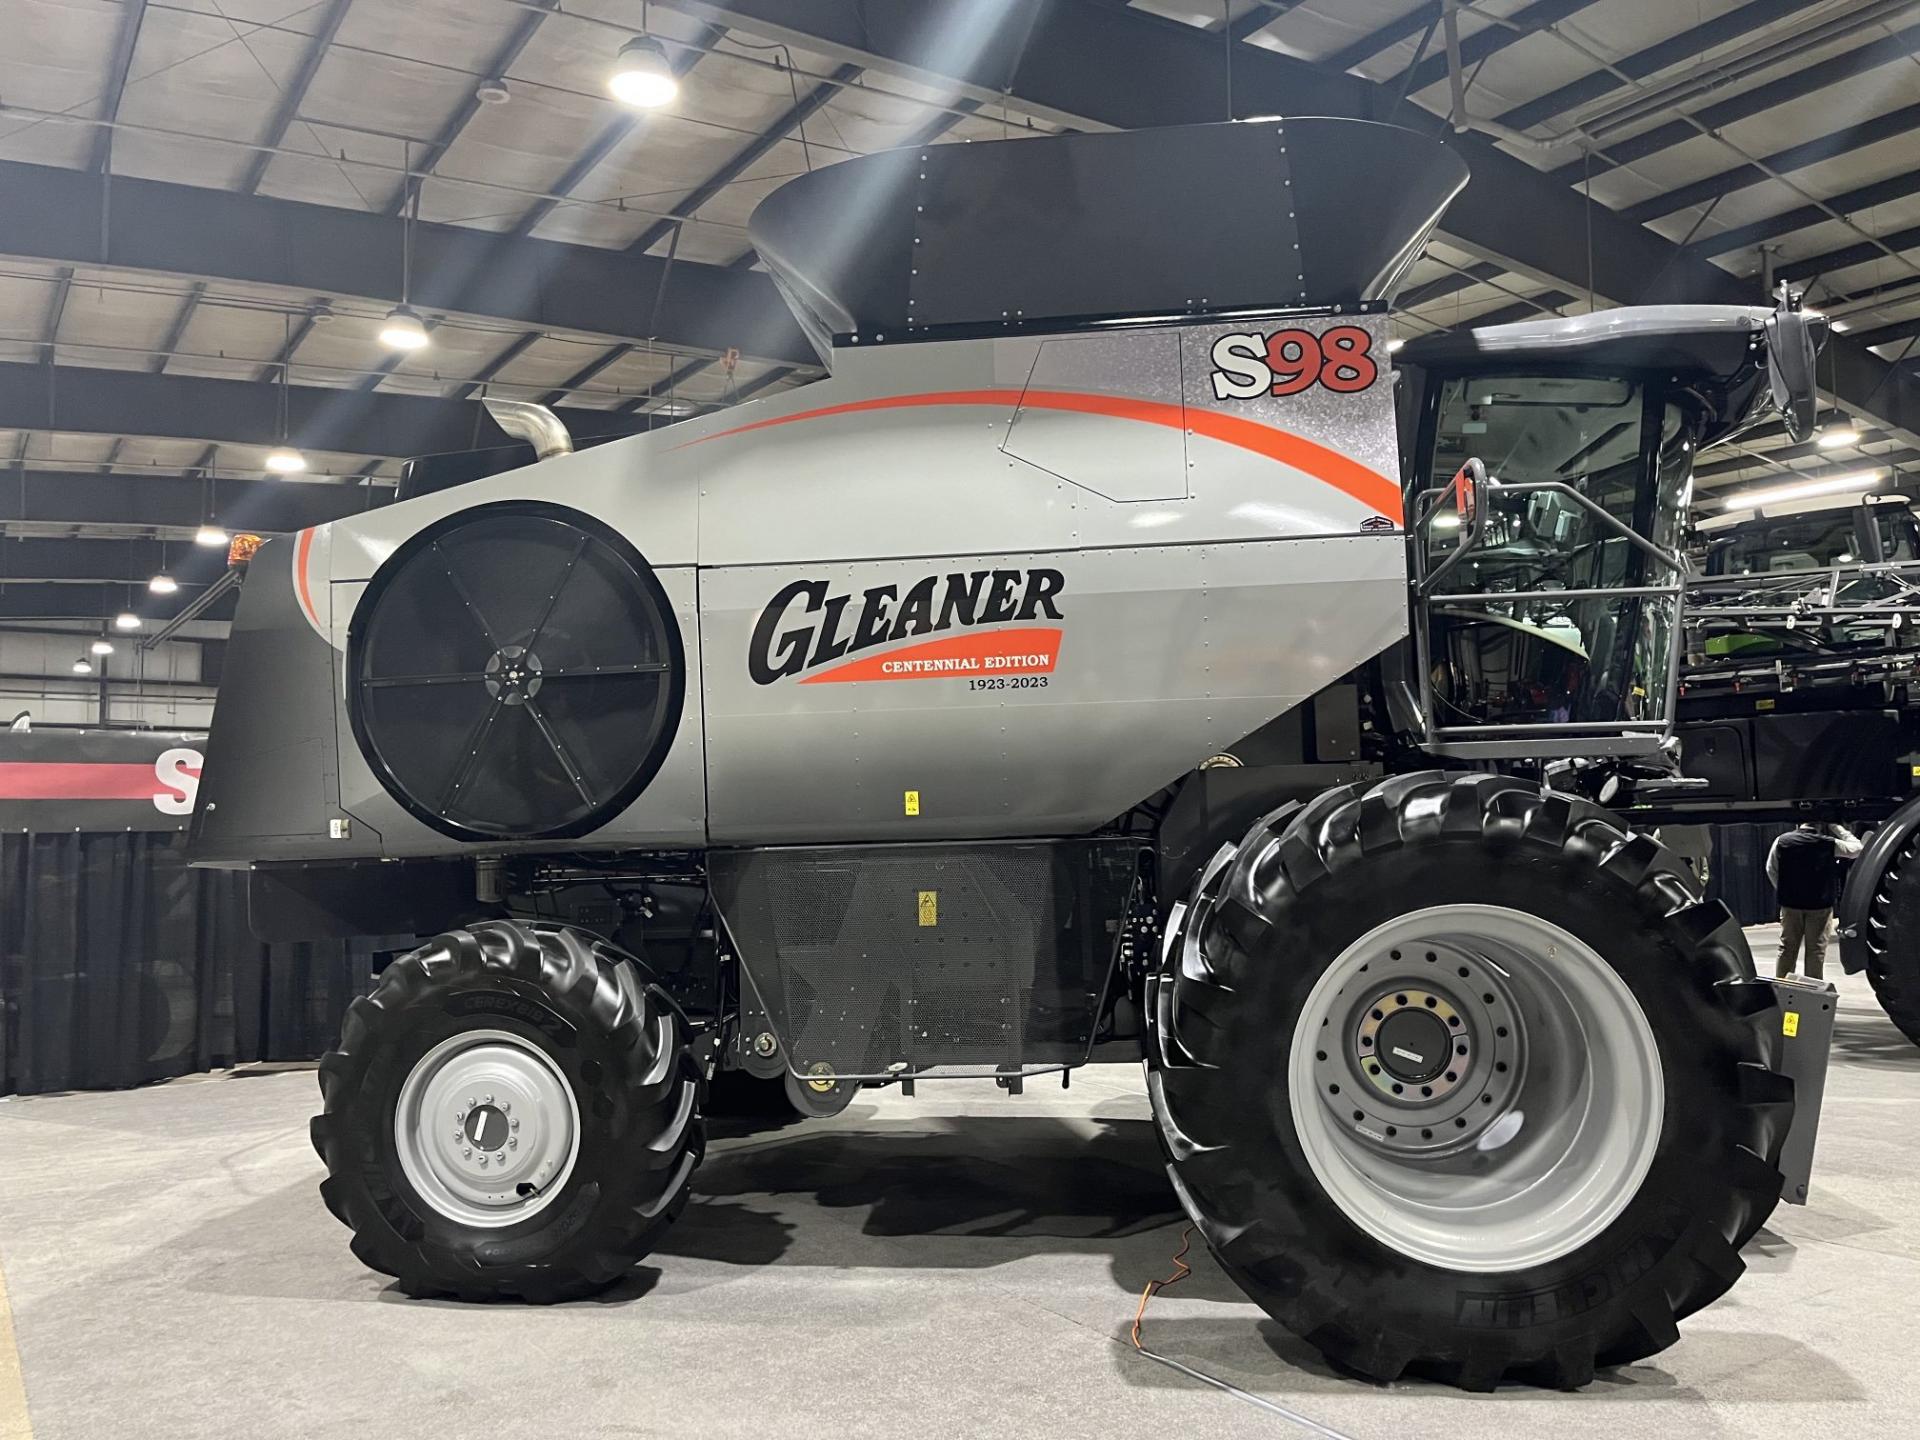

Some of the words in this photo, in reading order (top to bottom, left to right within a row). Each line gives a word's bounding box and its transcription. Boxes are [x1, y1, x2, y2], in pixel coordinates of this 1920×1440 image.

[1210, 325, 1378, 400] S98
[748, 568, 1065, 686] GLEANER
[881, 658, 980, 673] CENTENNIAL
[984, 654, 1050, 669] EDITION
[968, 676, 1049, 691] 1923-2023
